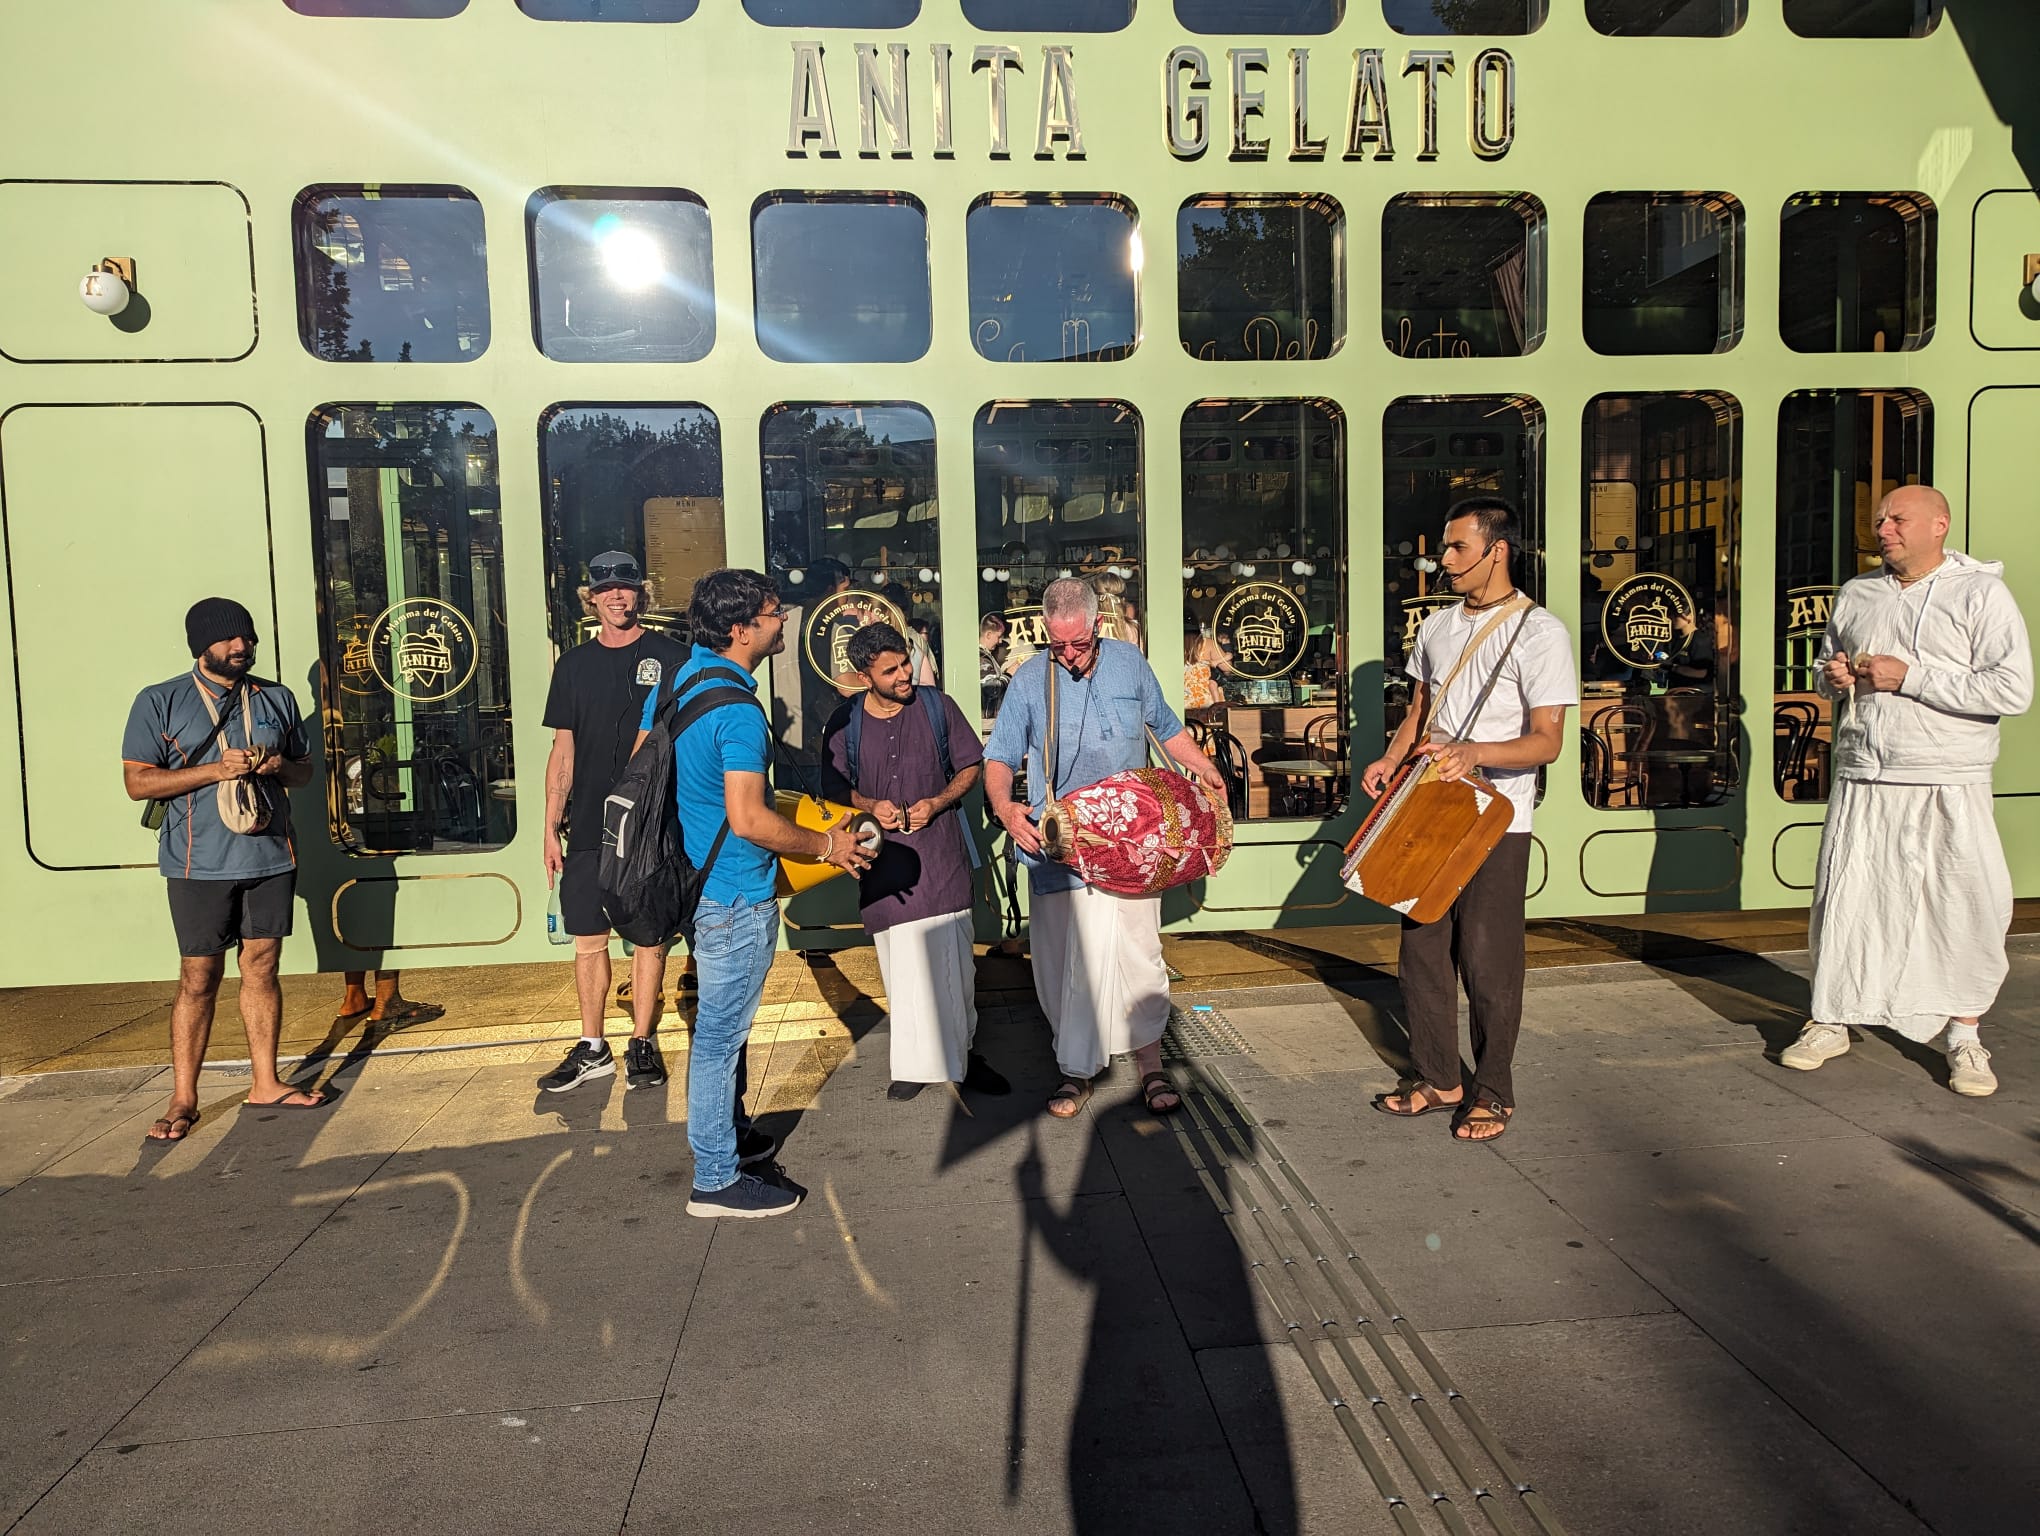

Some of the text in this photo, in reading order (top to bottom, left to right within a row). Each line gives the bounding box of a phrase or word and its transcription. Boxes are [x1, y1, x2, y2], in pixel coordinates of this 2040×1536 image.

[785, 41, 1518, 162] ANITA GELATO
[1650, 583, 1664, 592] del
[1262, 592, 1276, 602] del
[857, 601, 872, 611] del
[423, 608, 440, 618] del
[1630, 625, 1669, 638] ANITA
[402, 655, 448, 669] ANITA
